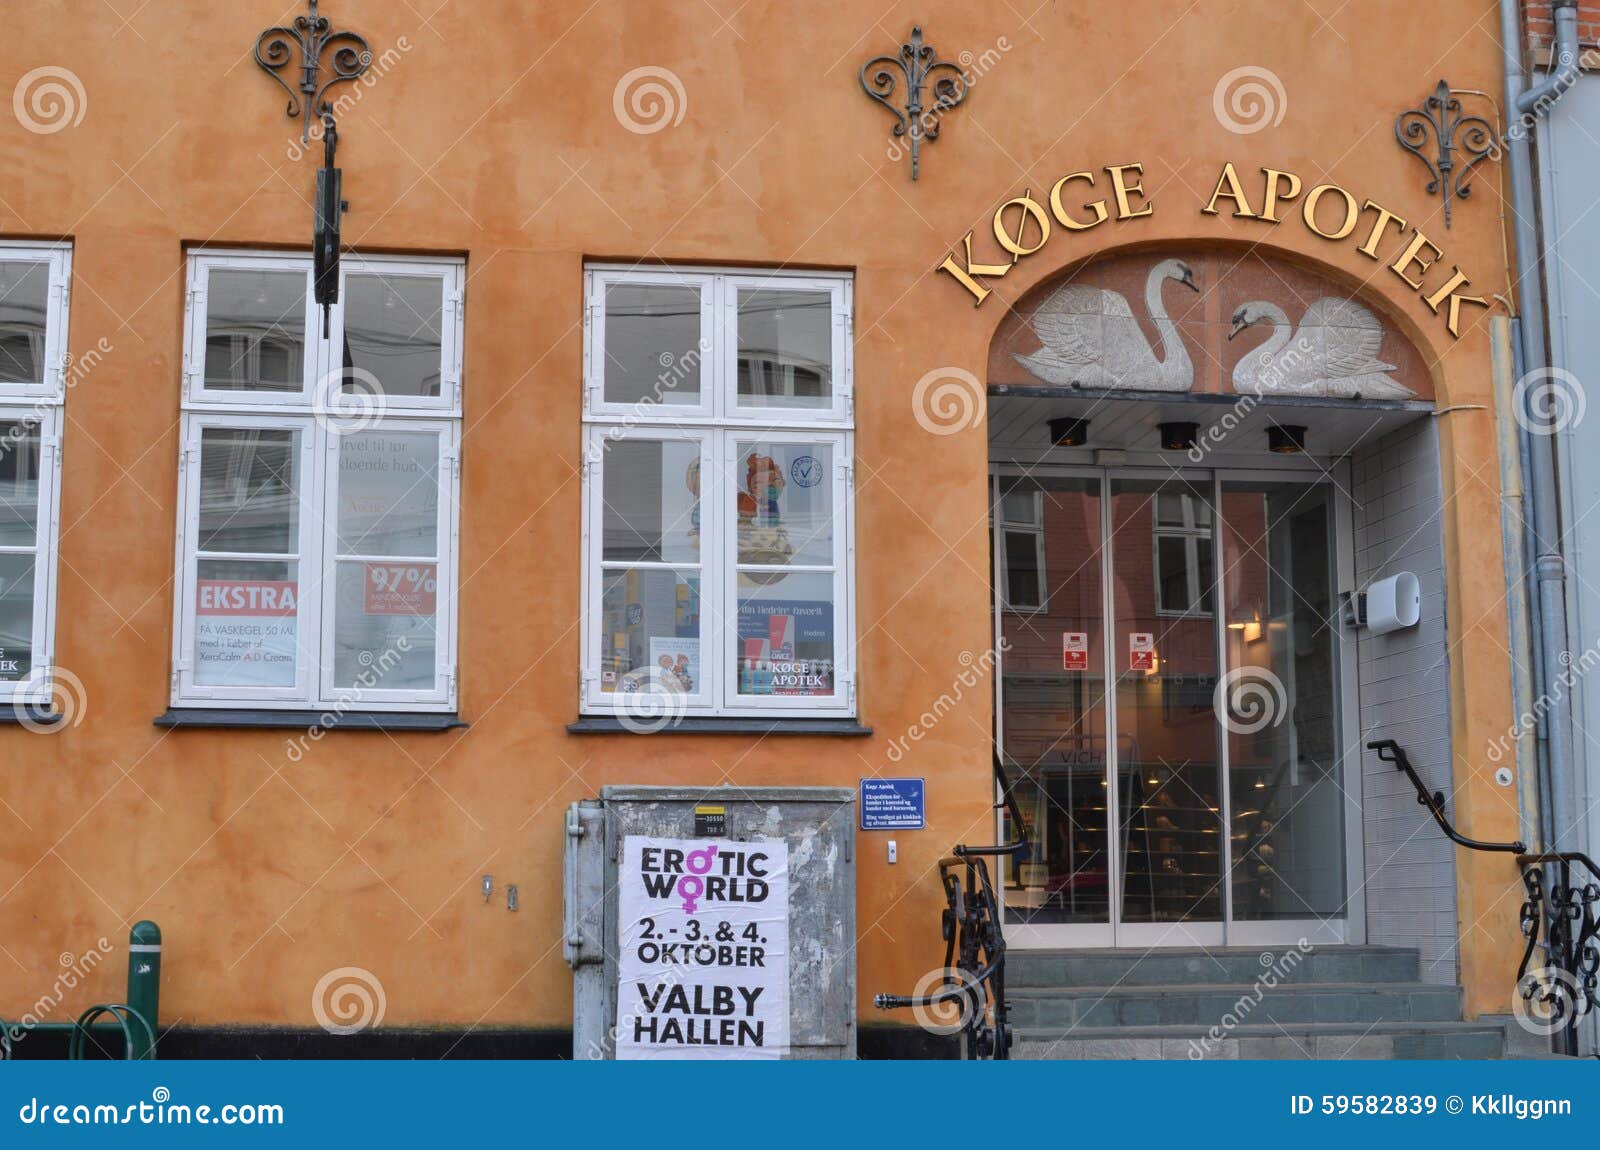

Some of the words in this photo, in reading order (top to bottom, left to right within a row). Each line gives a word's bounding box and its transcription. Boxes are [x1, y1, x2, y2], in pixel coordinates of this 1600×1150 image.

[936, 161, 1153, 308] KØGE
[1201, 161, 1490, 338] APOTEK
[370, 567, 436, 592] 97%
[200, 586, 297, 609] EKSTRA
[0, 661, 18, 670] EK
[772, 662, 809, 673] KØGE
[771, 675, 823, 685] APOTEK
[1061, 751, 1105, 764] VICH
[641, 846, 769, 877] EROTIC
[641, 873, 769, 908] WORLD
[639, 917, 664, 939] 2.
[715, 921, 735, 942] &
[742, 921, 768, 943] 4.
[637, 942, 766, 967] OKTOBER
[637, 983, 765, 1017] VALBY
[633, 1017, 765, 1047] HALLEN
